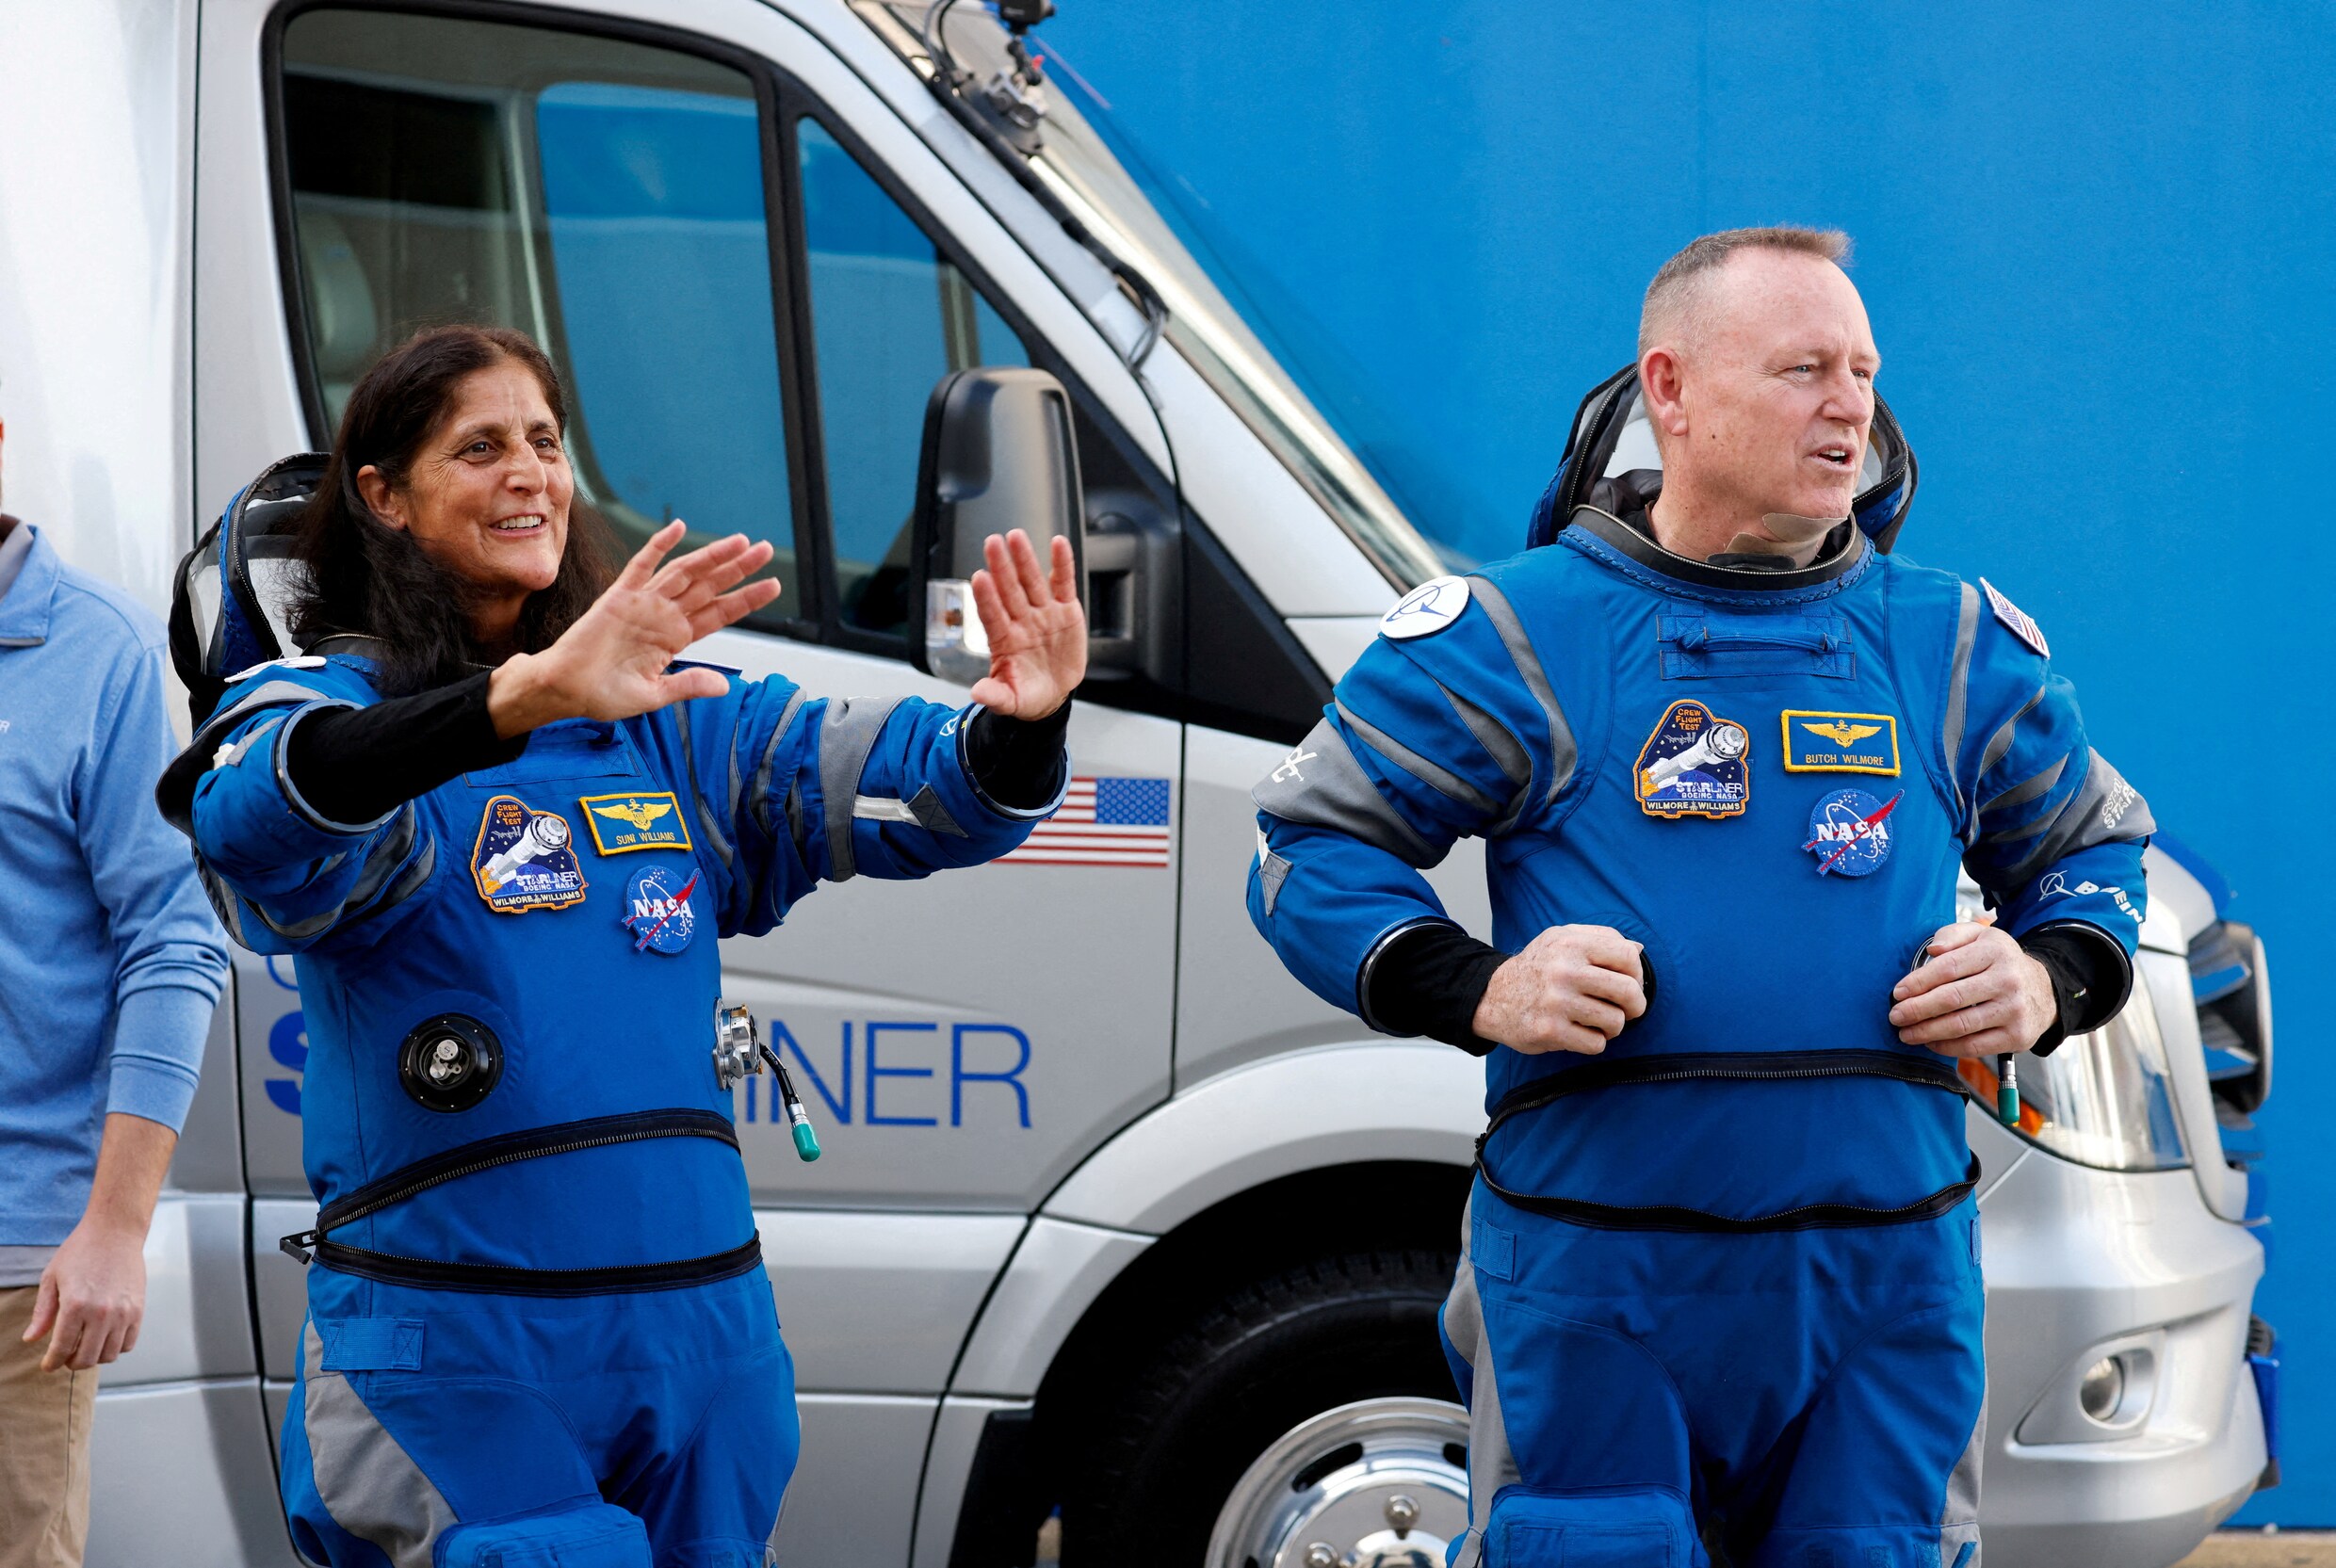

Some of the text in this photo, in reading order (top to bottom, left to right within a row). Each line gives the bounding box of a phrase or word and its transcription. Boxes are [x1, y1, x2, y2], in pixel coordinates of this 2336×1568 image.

[1679, 722, 1700, 731] TEST
[1805, 753, 1885, 767] BUTCH WILMORE
[1676, 781, 1744, 794] STARLINER
[1647, 801, 1741, 811] WILMORE WILLIAMS
[2103, 783, 2136, 830] STAR
[502, 817, 522, 826] TEST
[1815, 820, 1890, 842] NASA
[616, 832, 676, 845] SUNI WILLIAMS
[515, 871, 579, 886] STARLINER
[493, 890, 581, 907] WILMORE WILLIAMS
[632, 897, 694, 919] NASA
